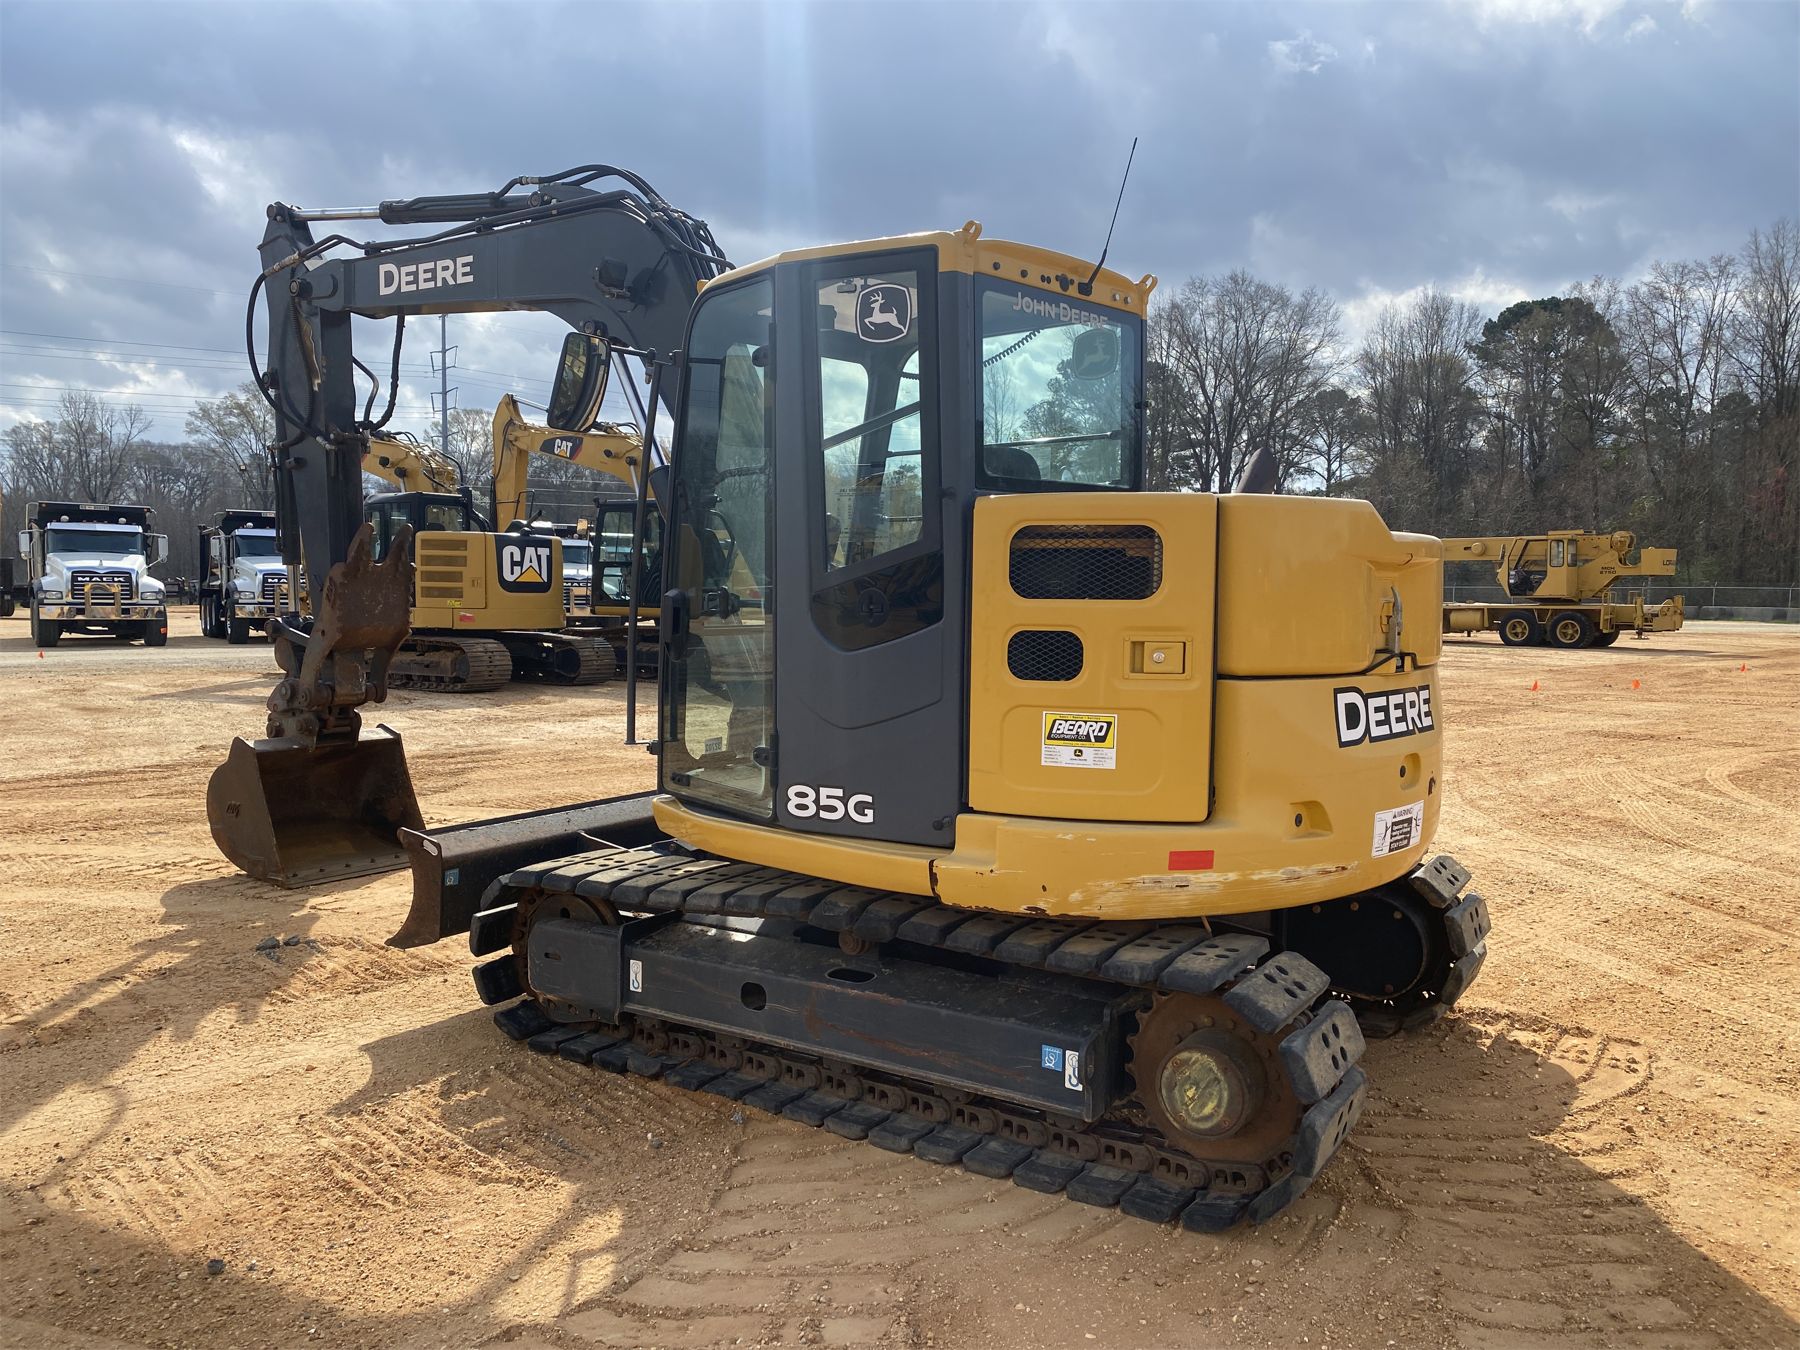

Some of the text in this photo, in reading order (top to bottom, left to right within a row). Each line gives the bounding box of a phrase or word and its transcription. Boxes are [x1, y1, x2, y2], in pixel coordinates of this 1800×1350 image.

[378, 255, 475, 296] DEERE
[1012, 292, 1108, 329] JOHN DEERE
[553, 438, 573, 458] CAT
[502, 545, 550, 583] CAT
[1051, 719, 1108, 742] BEARD
[1335, 689, 1434, 743] DEERE
[786, 784, 874, 823] 85G
